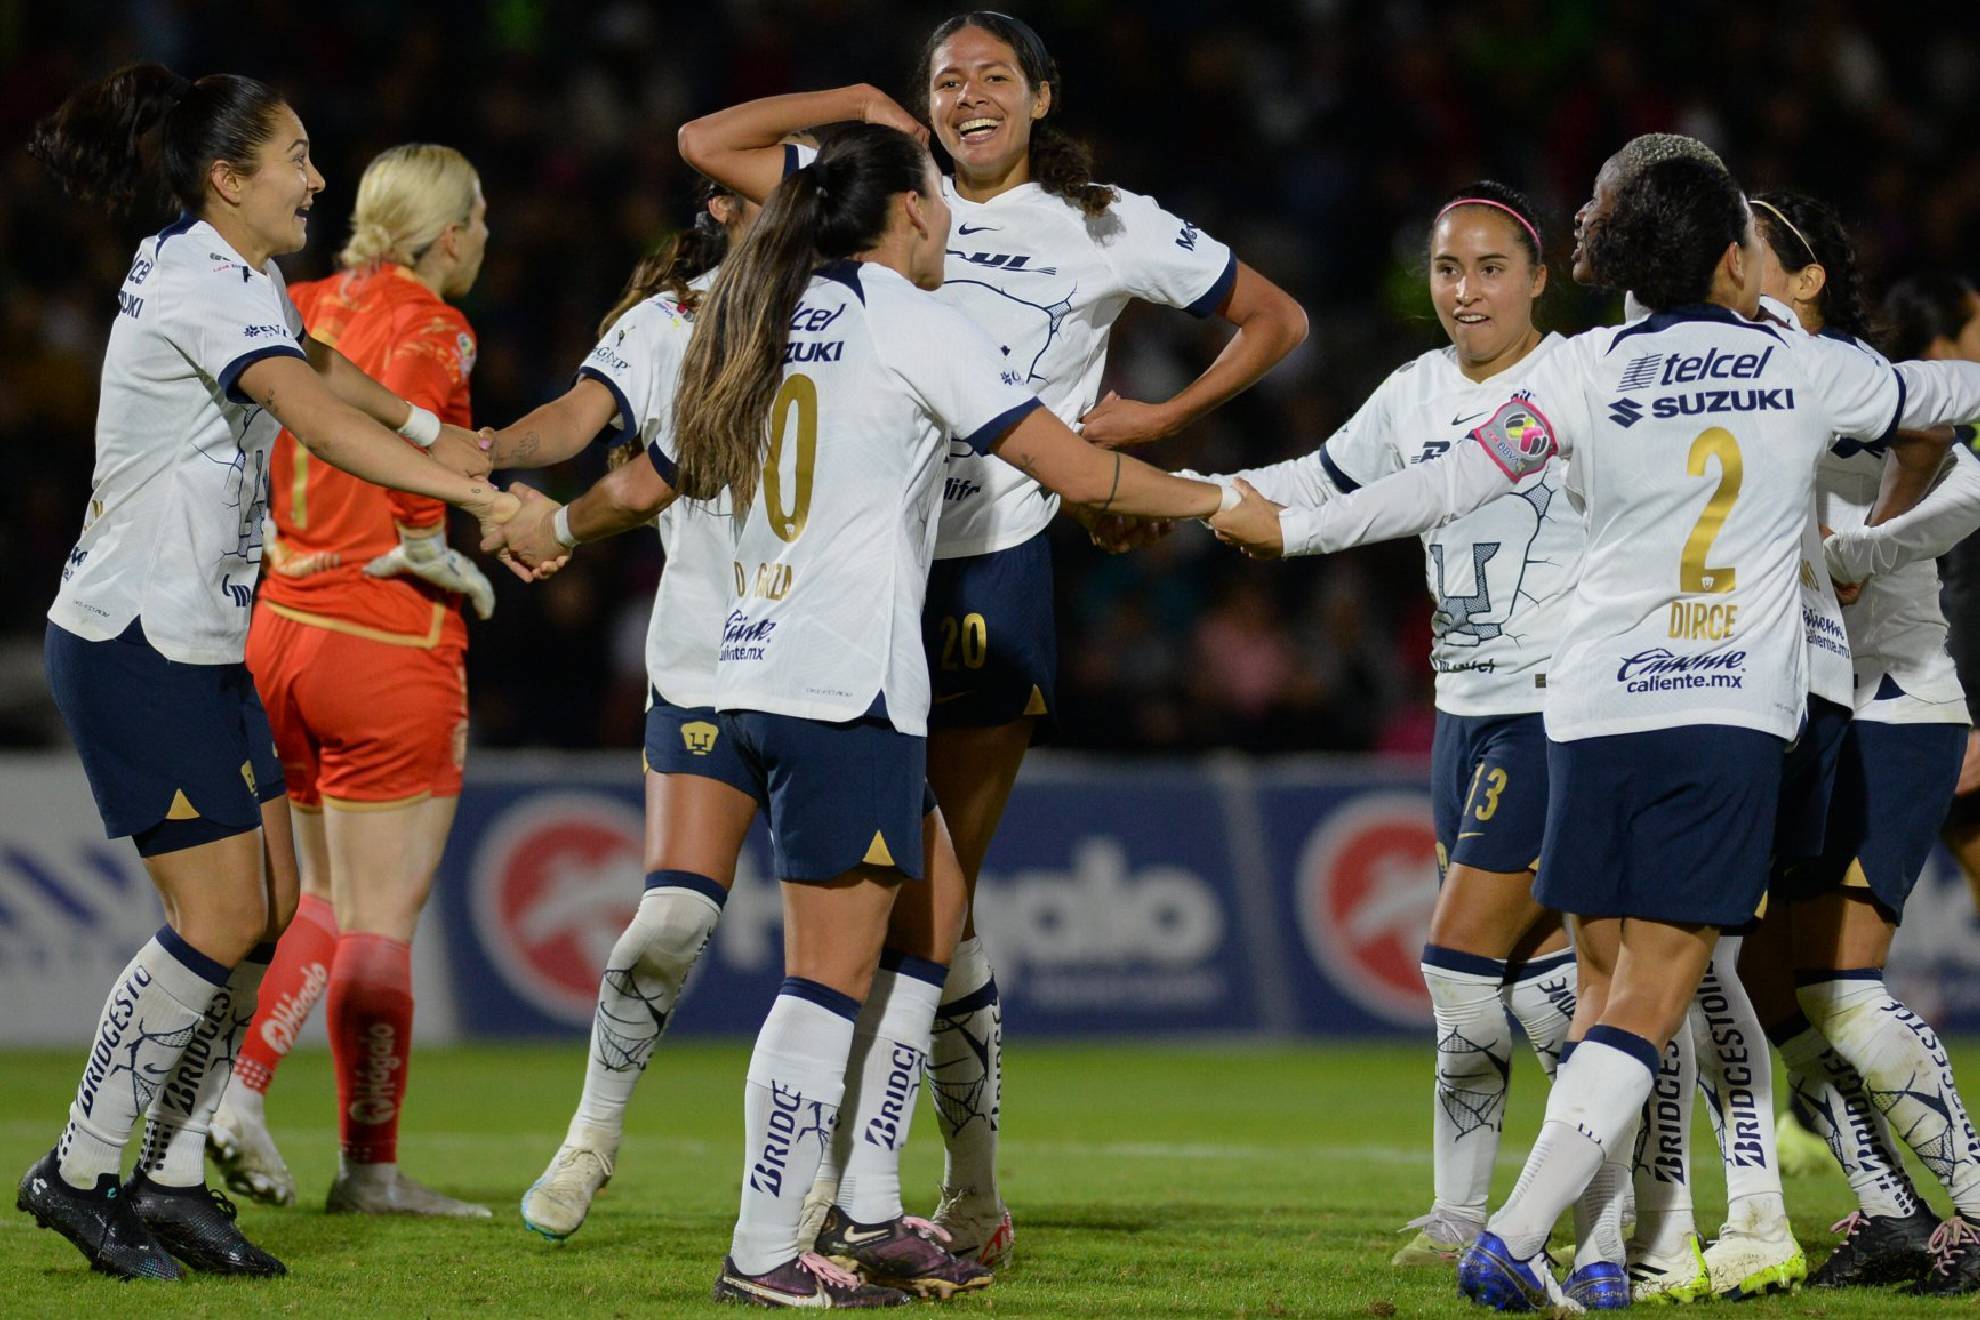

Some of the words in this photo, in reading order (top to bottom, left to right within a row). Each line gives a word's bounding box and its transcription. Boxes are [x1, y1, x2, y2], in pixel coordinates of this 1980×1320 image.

[782, 341, 845, 364] ZUKI
[1660, 345, 1775, 386] telcel
[1652, 388, 1795, 419] SUZUKI
[1680, 426, 1744, 594] 2
[941, 612, 987, 669] 20
[1667, 601, 1738, 641] DIRCE
[1627, 674, 1743, 693] caliente.mx
[1463, 762, 1508, 822] 13
[76, 965, 152, 1119] BRIDGESTO
[1655, 1040, 1686, 1185] BRIDGES
